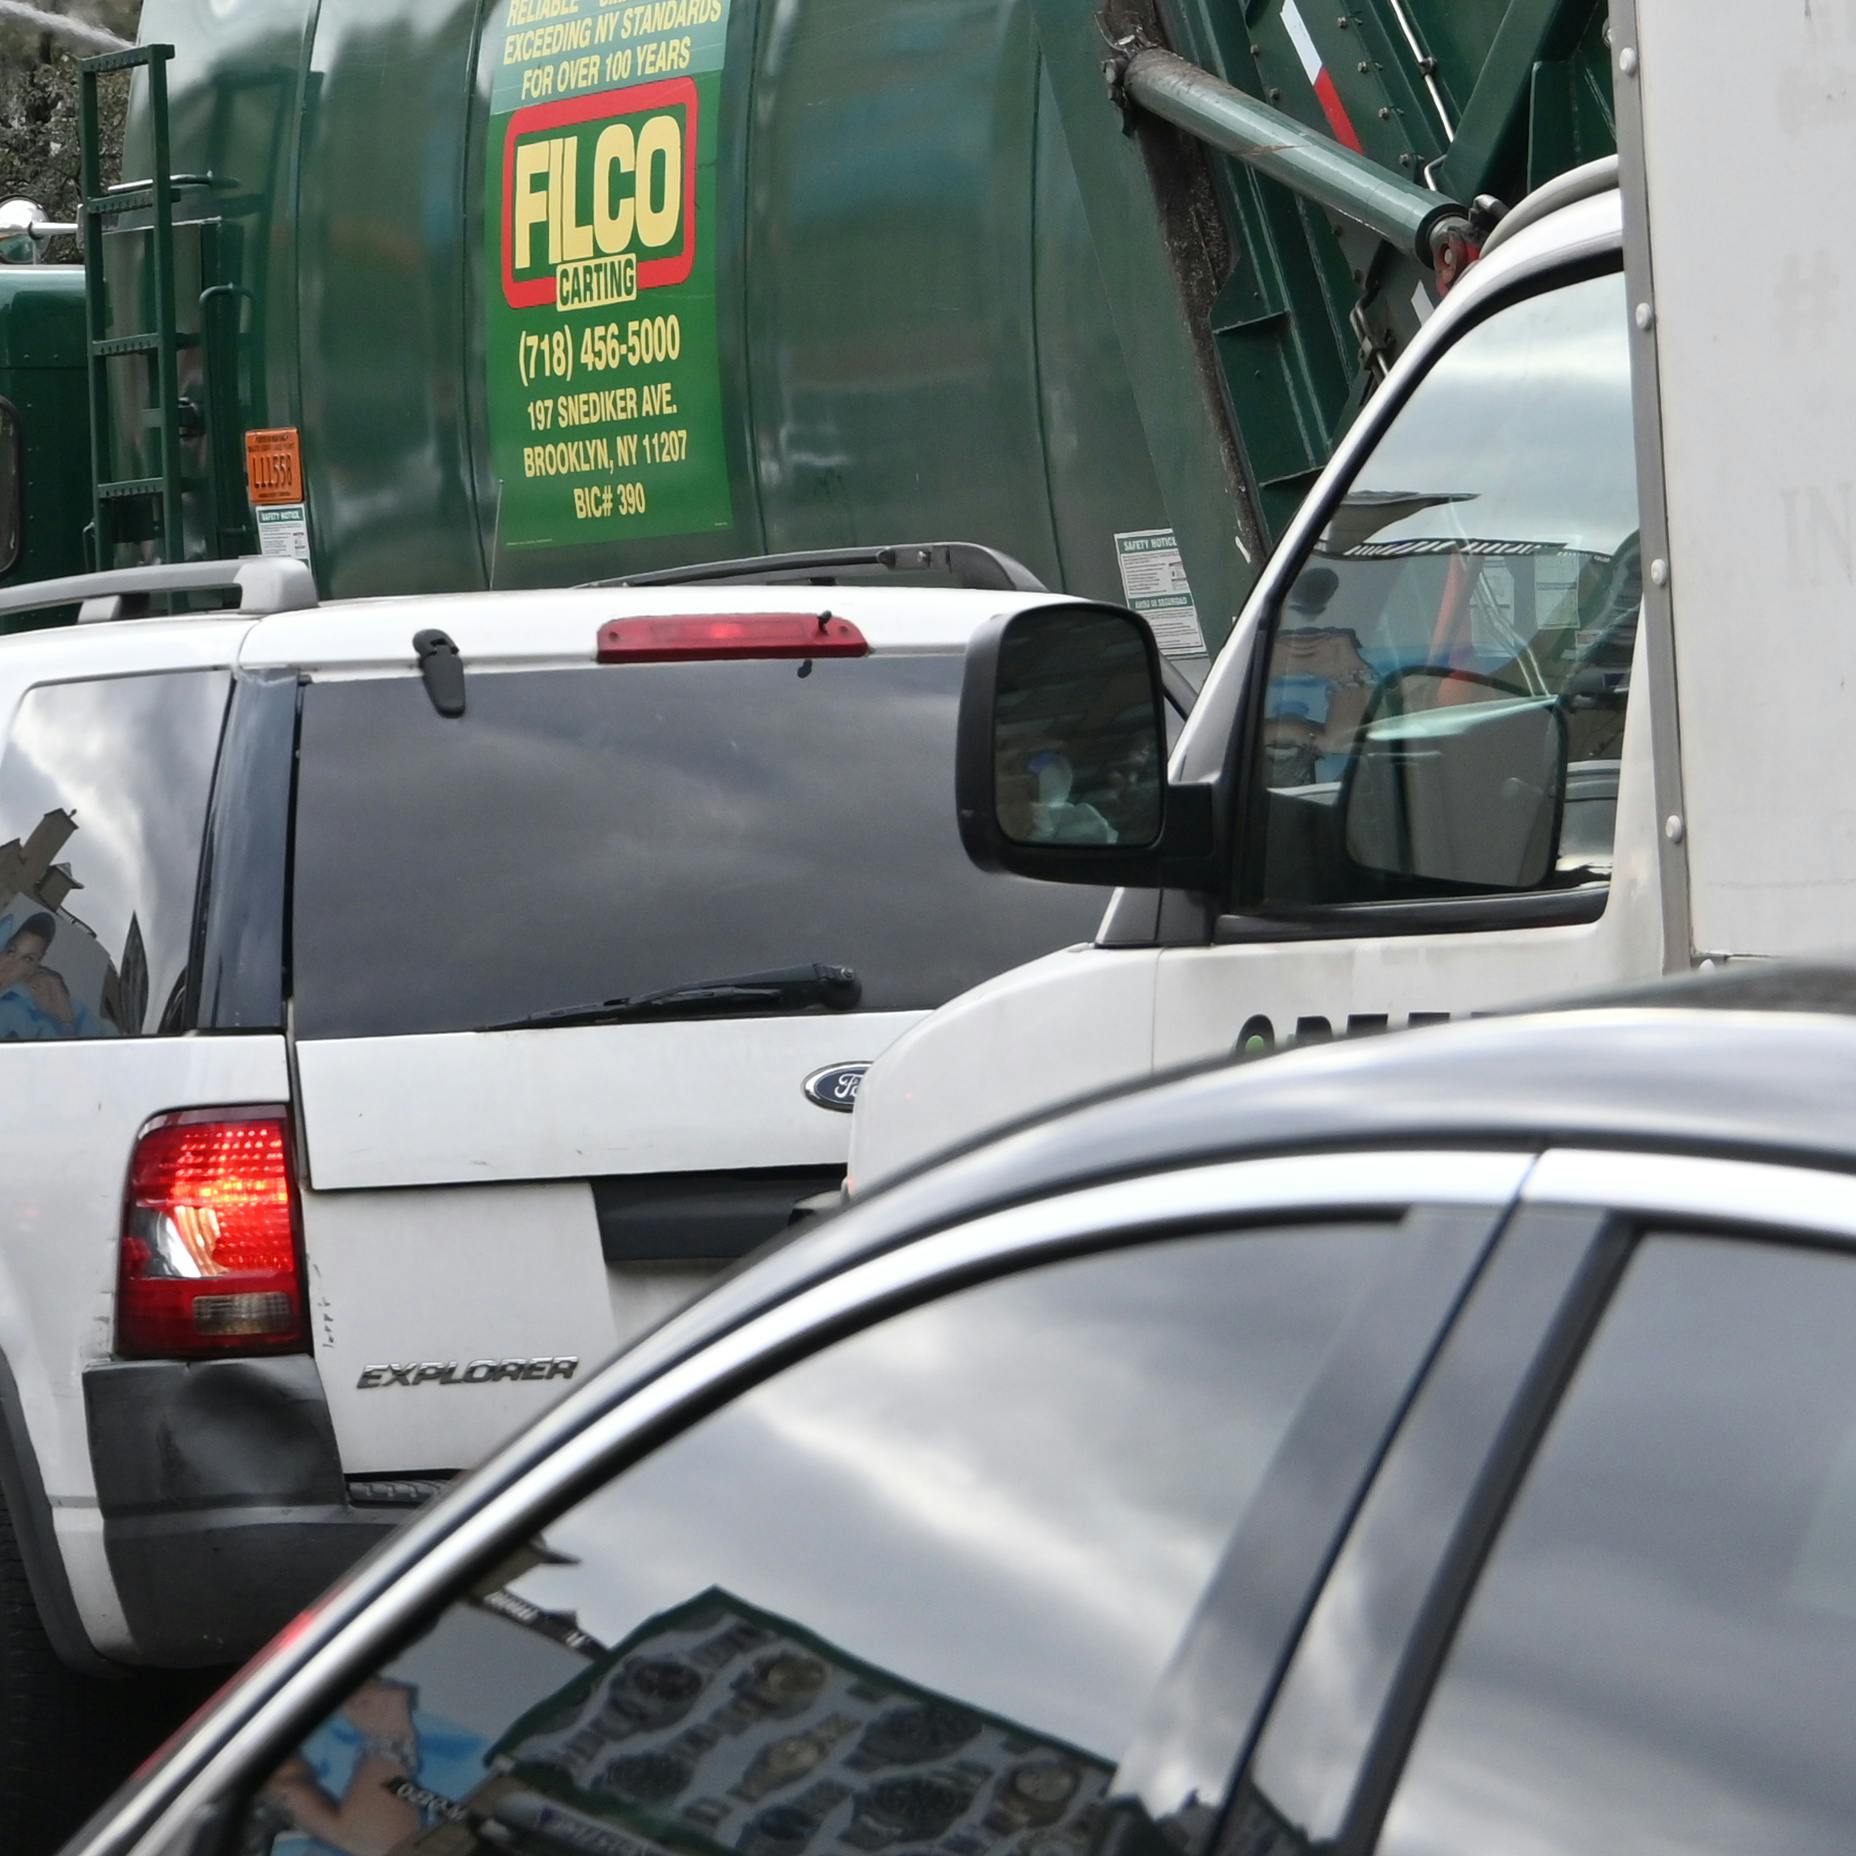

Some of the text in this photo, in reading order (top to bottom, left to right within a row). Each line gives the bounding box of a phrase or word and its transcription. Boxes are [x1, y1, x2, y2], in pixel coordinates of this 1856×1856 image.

[504, 17, 592, 65] EXCEEDING
[594, 12, 620, 44] NY
[521, 36, 691, 100] FOR OVER 100 YEARS
[515, 115, 681, 269] FILCO
[559, 257, 635, 306] CARTING
[519, 314, 681, 386] (718) 456-5000
[528, 383, 677, 430] 197 SNEDIKER AVE.
[524, 430, 687, 474] BROOKLYN, NY 11207
[574, 483, 645, 519] BIC# 390
[1124, 537, 1177, 551] SAFETY NOTICE
[356, 1356, 578, 1389] EXPLORER
